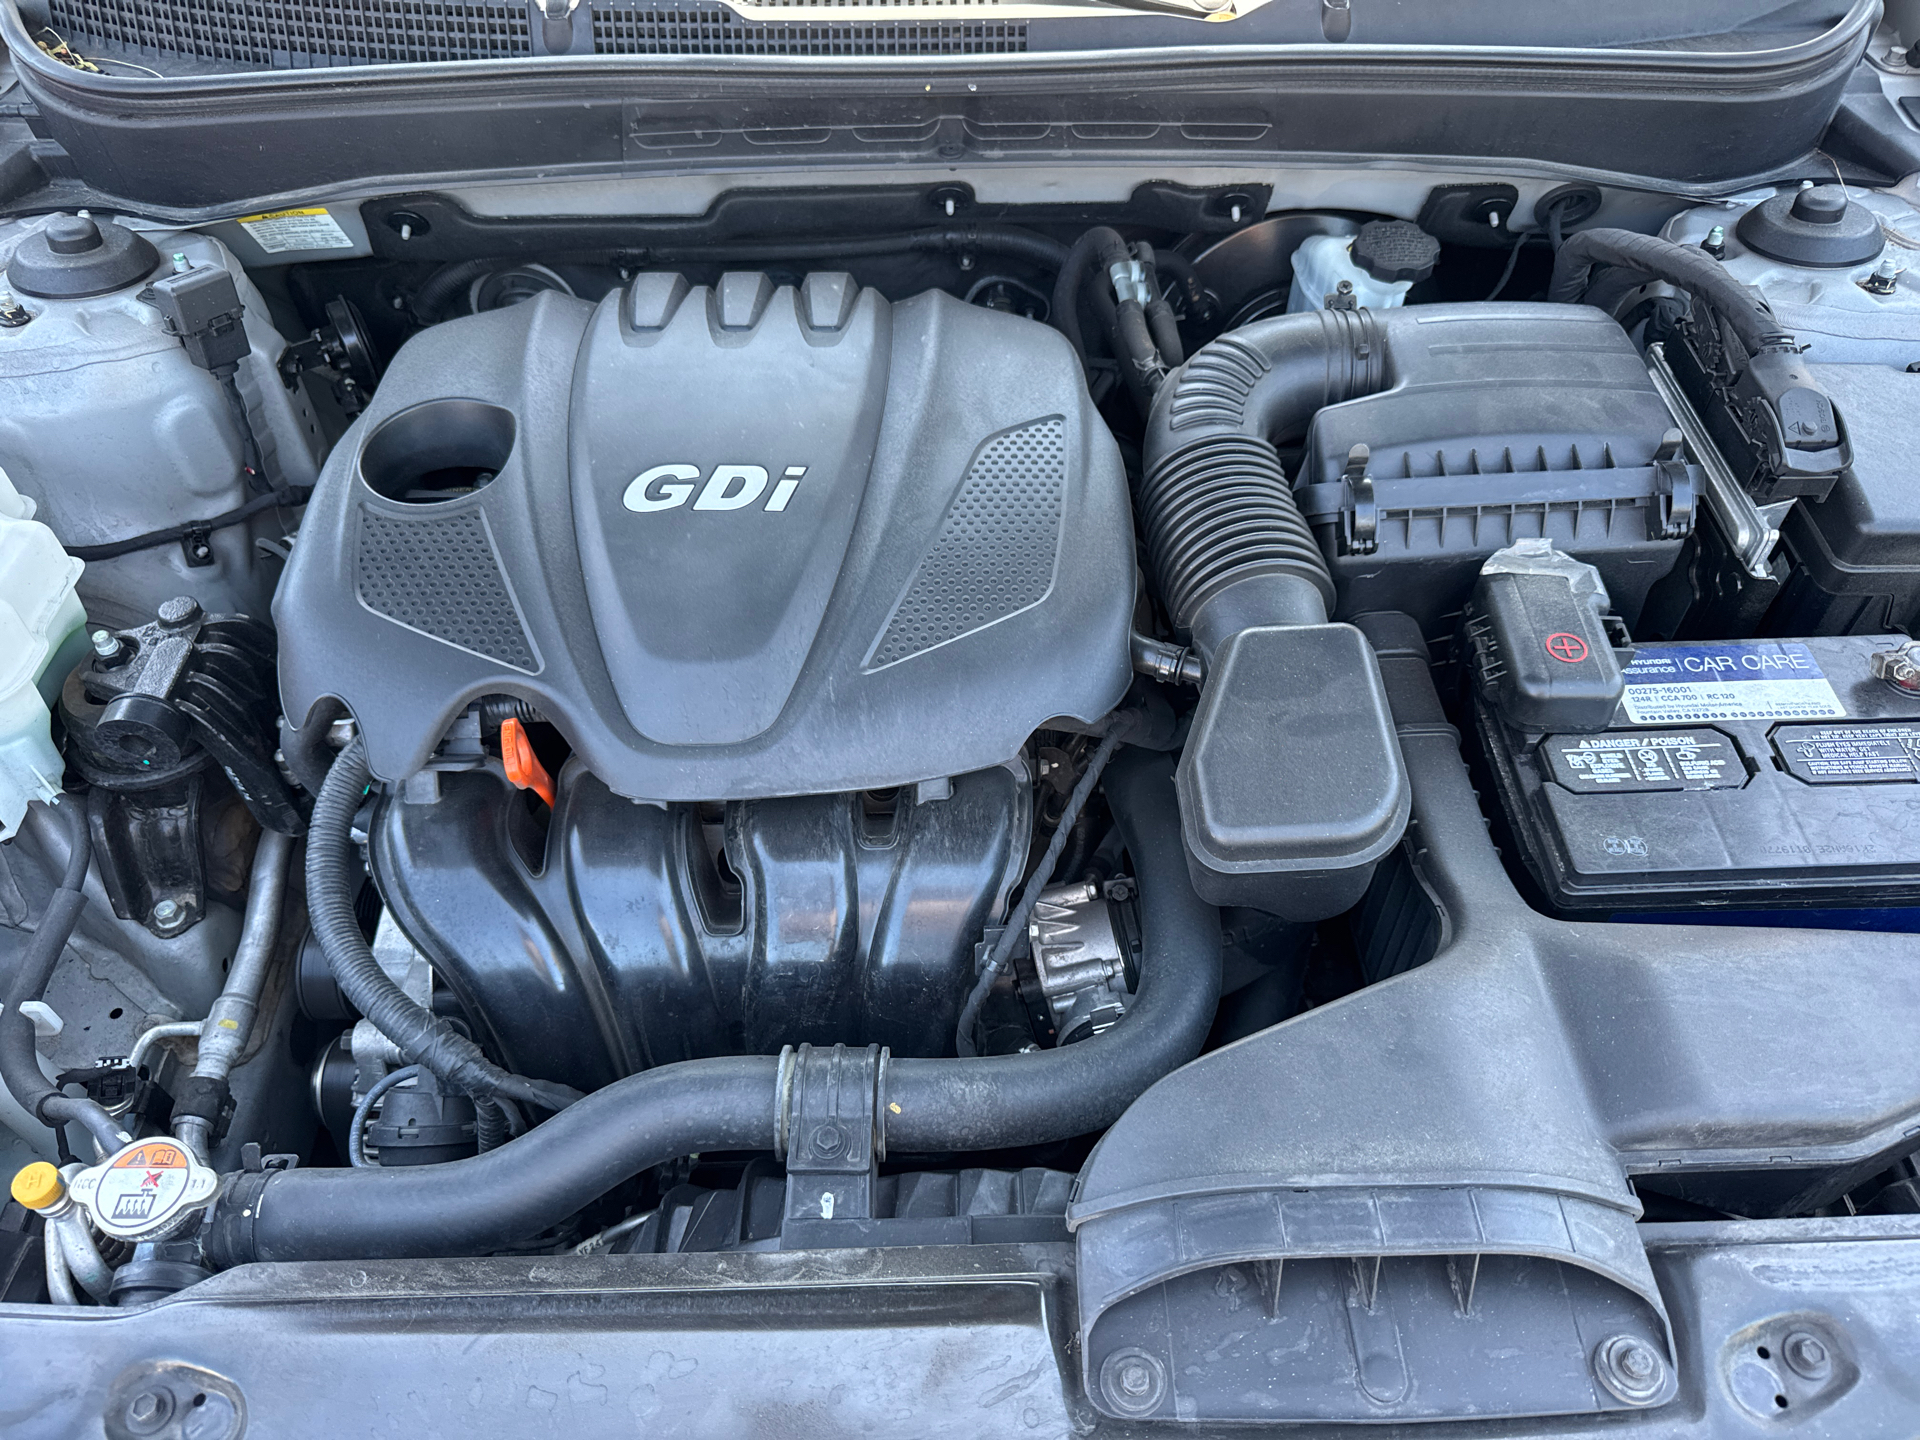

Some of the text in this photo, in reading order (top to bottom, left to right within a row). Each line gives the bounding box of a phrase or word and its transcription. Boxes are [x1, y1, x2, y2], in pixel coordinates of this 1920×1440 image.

[268, 210, 305, 219] CAUTION
[622, 463, 810, 513] GDi
[1630, 658, 1673, 666] HYUNDAI
[1683, 654, 1810, 672] CAR CARE
[1627, 686, 1692, 695] 00275-16001
[1589, 739, 1641, 748] DANGER
[1650, 736, 1697, 746] POISON
[504, 746, 516, 766] OIL
[26, 1174, 43, 1189] H
